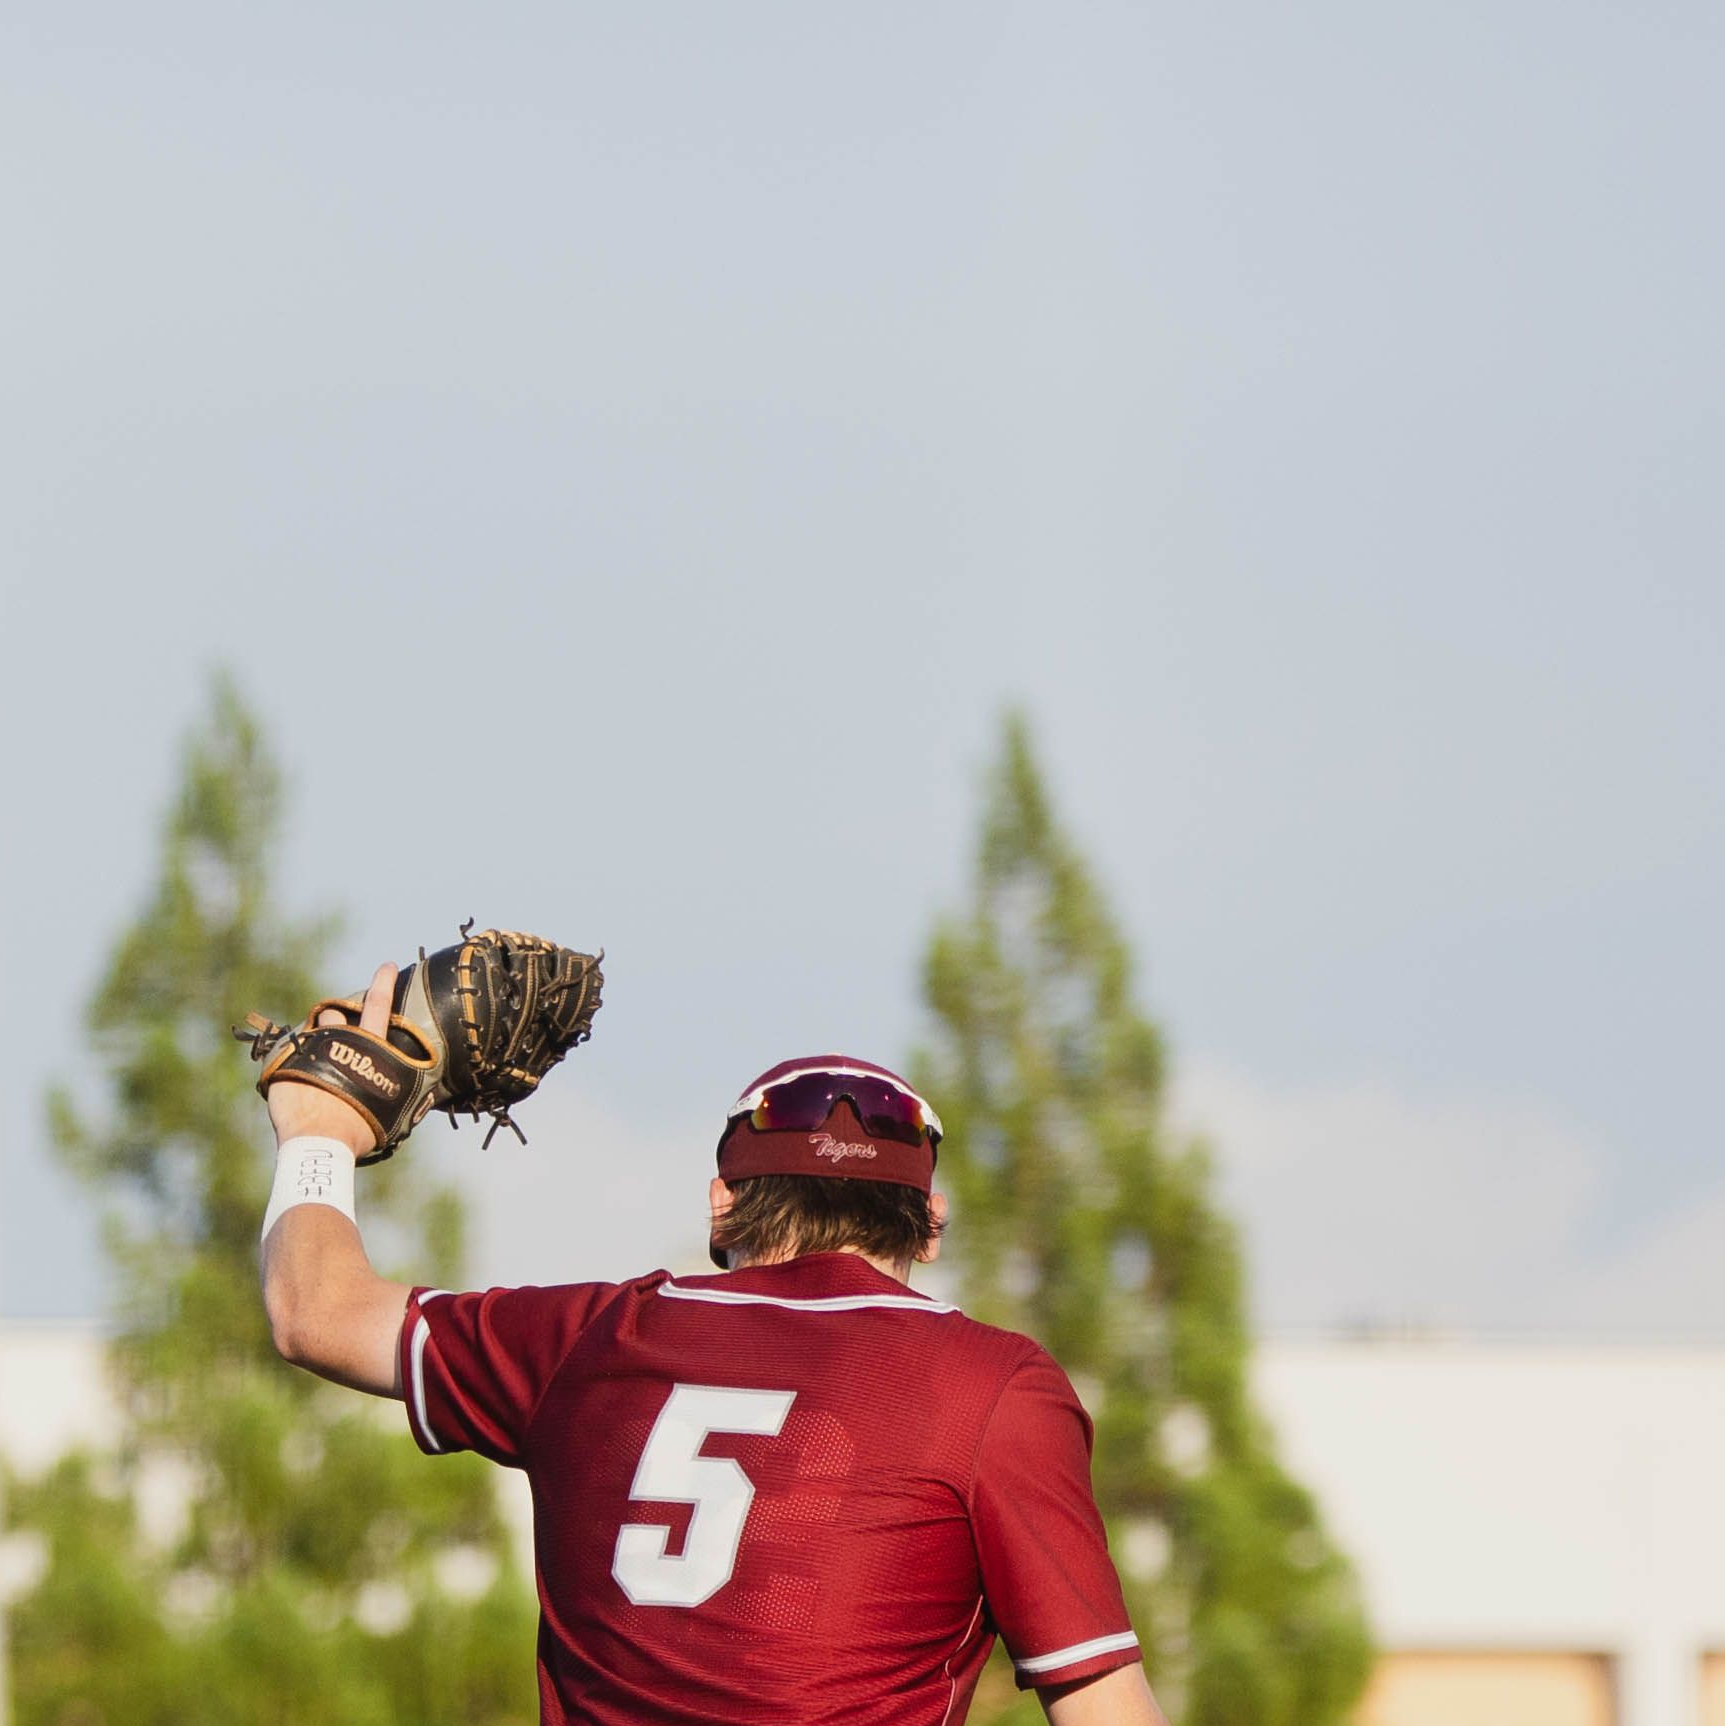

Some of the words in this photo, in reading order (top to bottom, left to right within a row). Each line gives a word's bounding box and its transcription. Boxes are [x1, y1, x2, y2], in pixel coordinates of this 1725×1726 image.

[329, 1040, 398, 1097] Wilson
[808, 1132, 878, 1163] Tigers
[611, 1382, 797, 1608] 5
